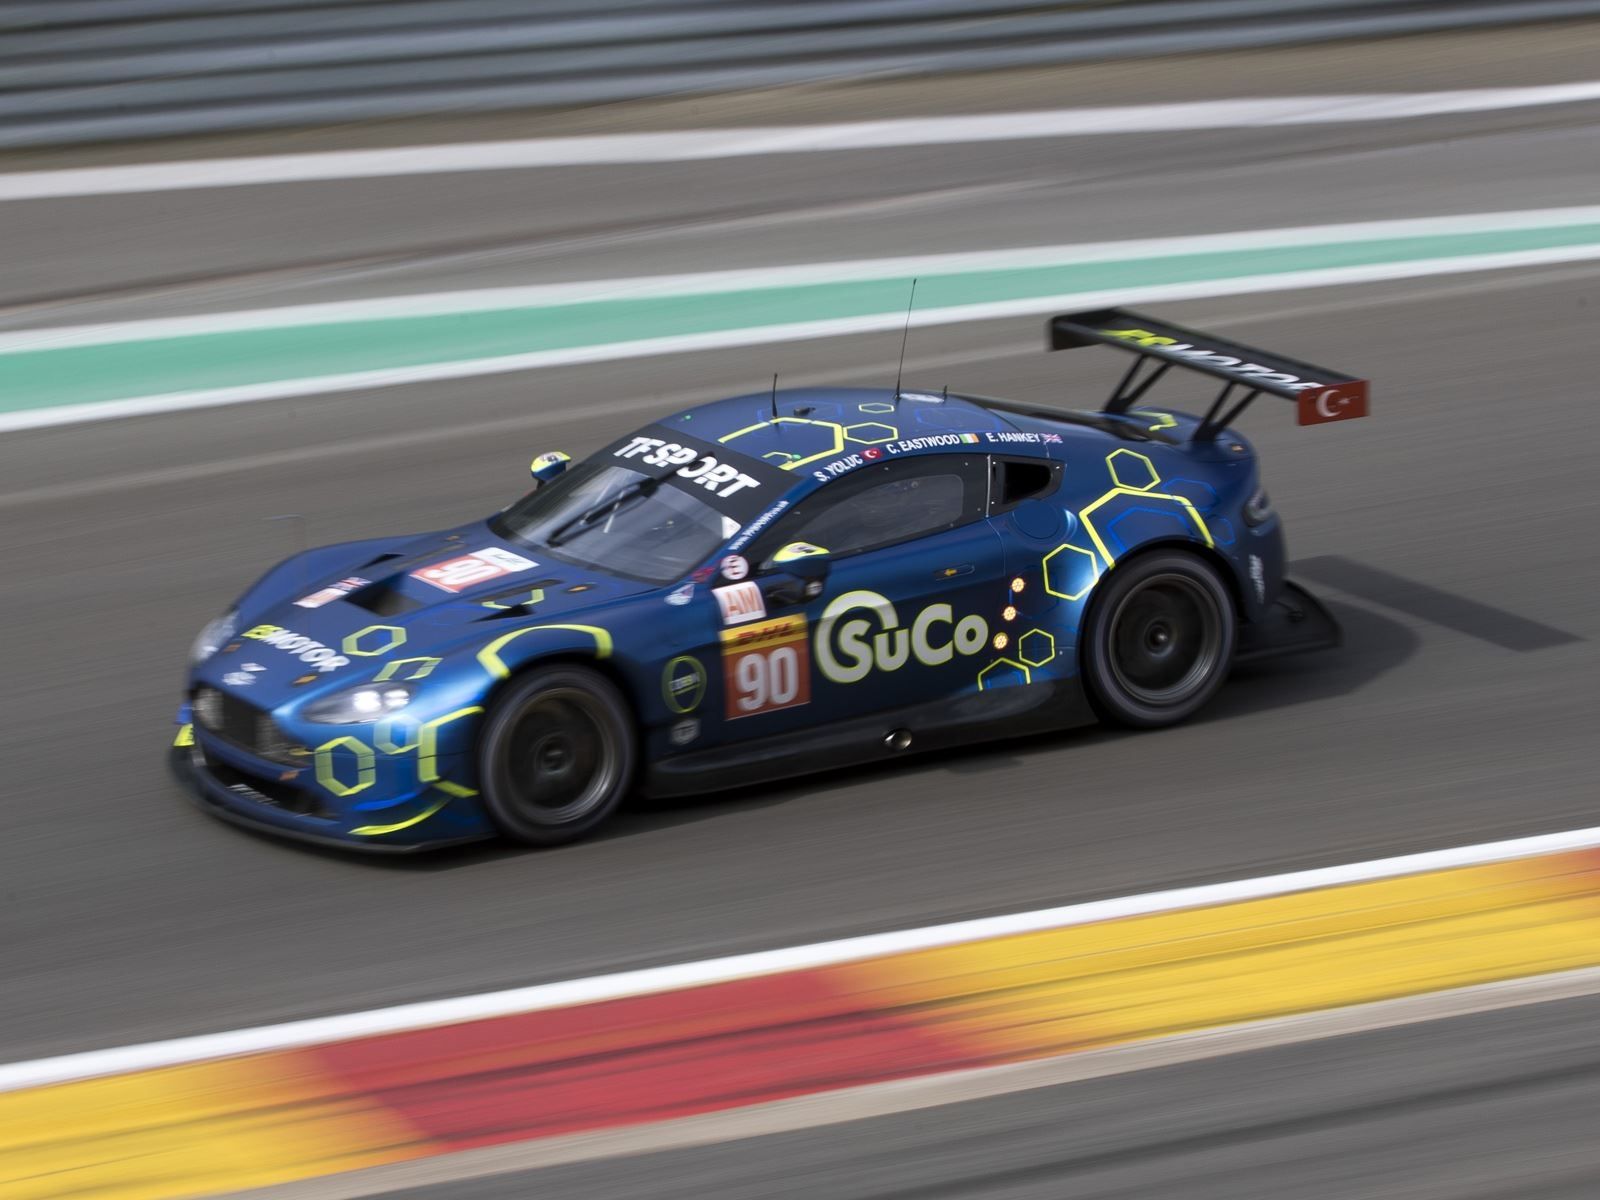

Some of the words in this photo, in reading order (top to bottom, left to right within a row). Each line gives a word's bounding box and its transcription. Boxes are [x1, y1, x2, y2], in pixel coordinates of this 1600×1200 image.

[886, 443, 901, 455] C.
[900, 433, 961, 453] EASTWOOD
[986, 432, 999, 443] E.
[1000, 432, 1042, 443] HANKEY
[813, 470, 829, 483] S.
[735, 646, 800, 712] 90
